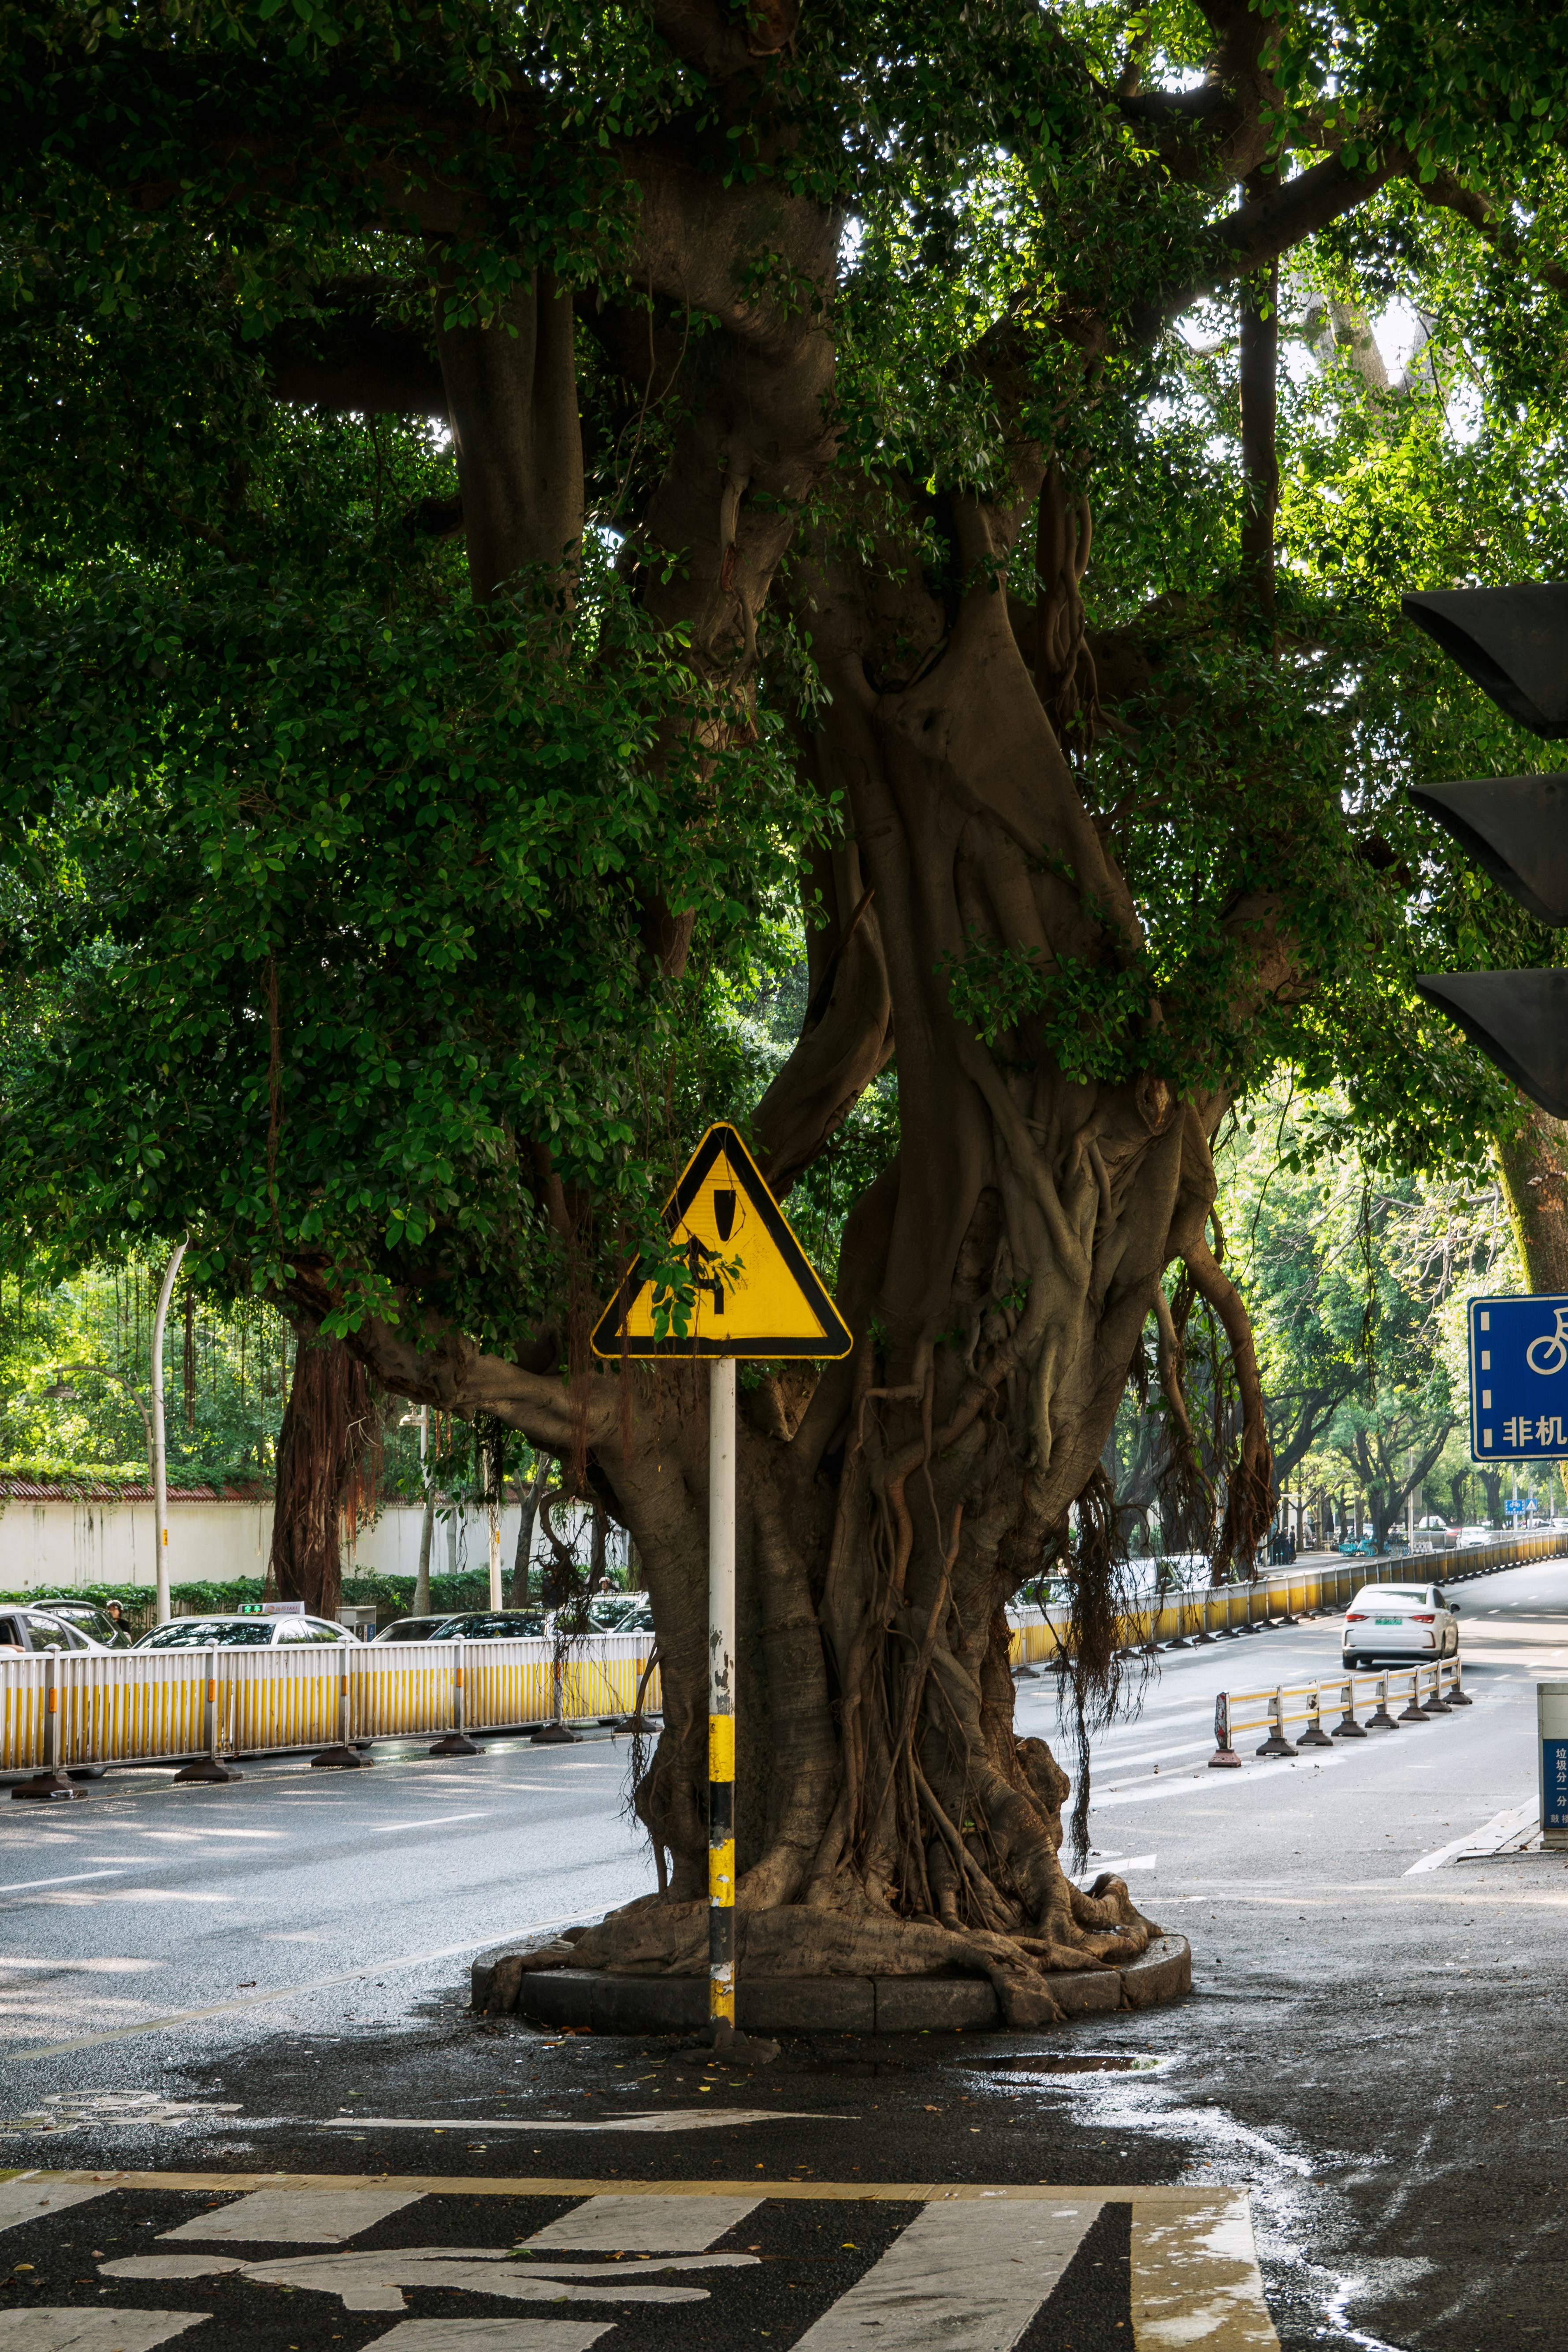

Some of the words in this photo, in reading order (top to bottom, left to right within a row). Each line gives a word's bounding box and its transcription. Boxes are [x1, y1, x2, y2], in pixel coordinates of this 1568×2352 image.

[1503, 1415, 1568, 1447] 非机
[245, 1605, 261, 1613] 空车
[1556, 1748, 1567, 1806] 垃圾分一分
